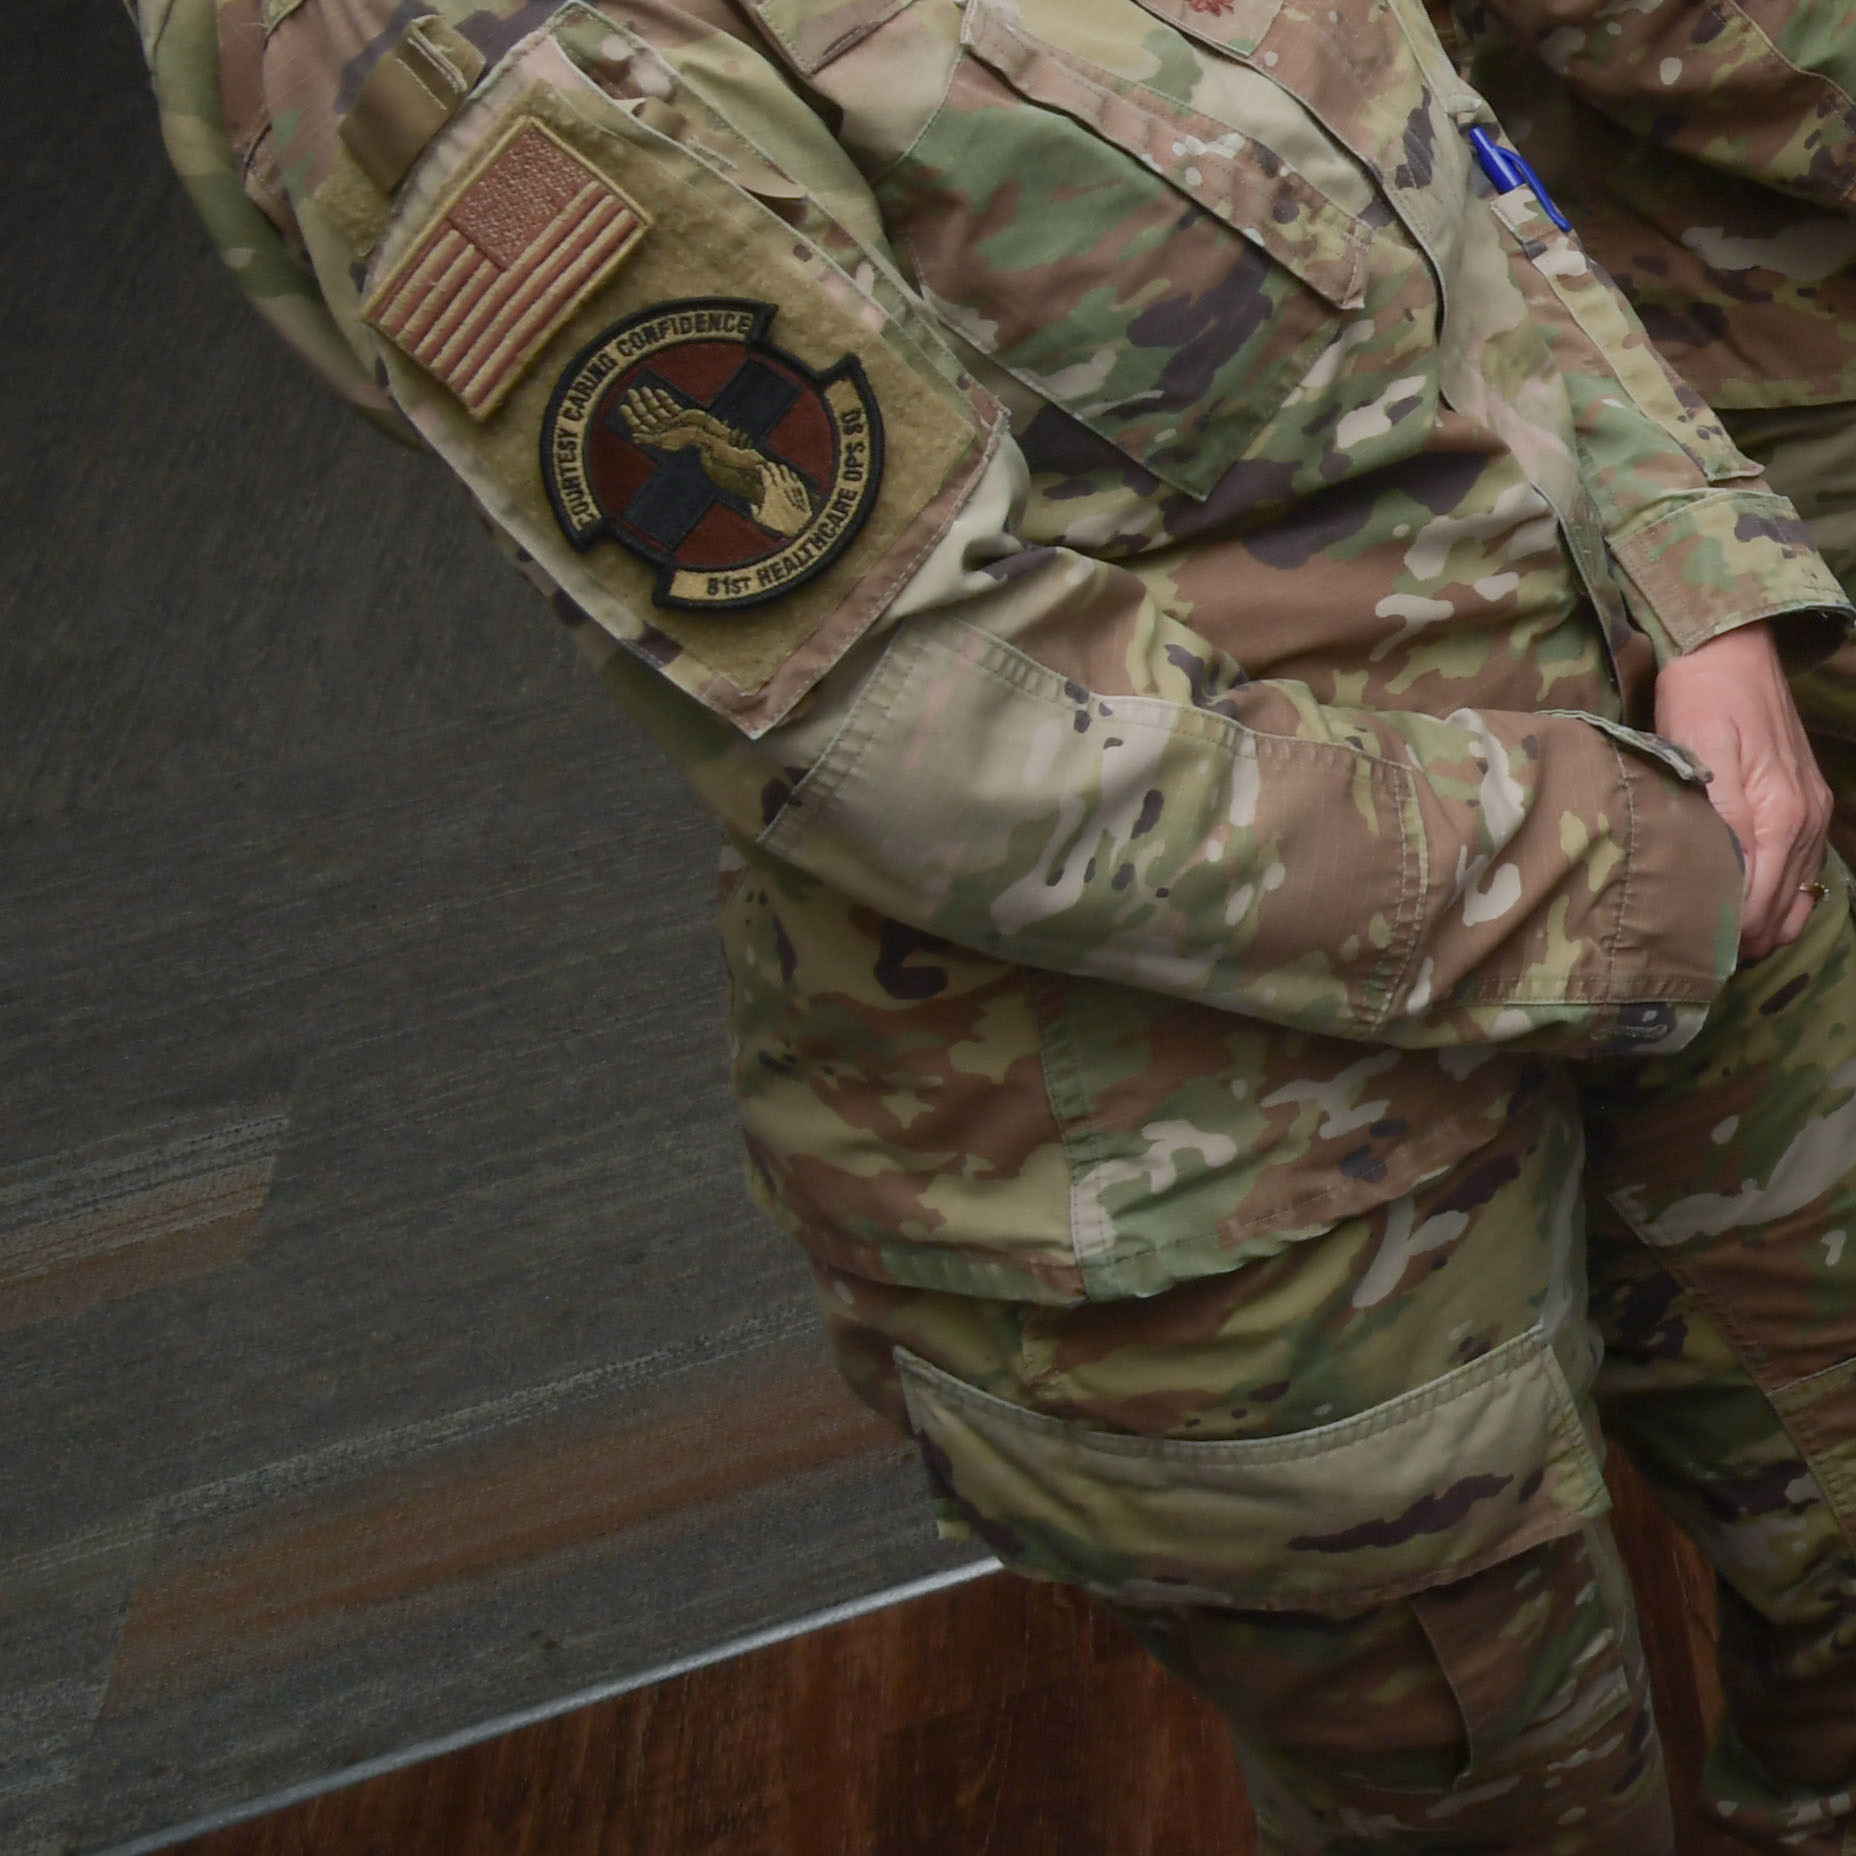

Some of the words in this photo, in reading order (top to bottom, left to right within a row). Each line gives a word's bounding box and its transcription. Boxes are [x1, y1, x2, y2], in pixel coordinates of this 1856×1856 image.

[615, 310, 751, 359] CONFIDENCE
[563, 349, 619, 422] CARING
[841, 407, 865, 438] SQ
[554, 429, 596, 530] COURTESY
[843, 441, 865, 483] OPS
[755, 487, 859, 587] HEALTHCARE
